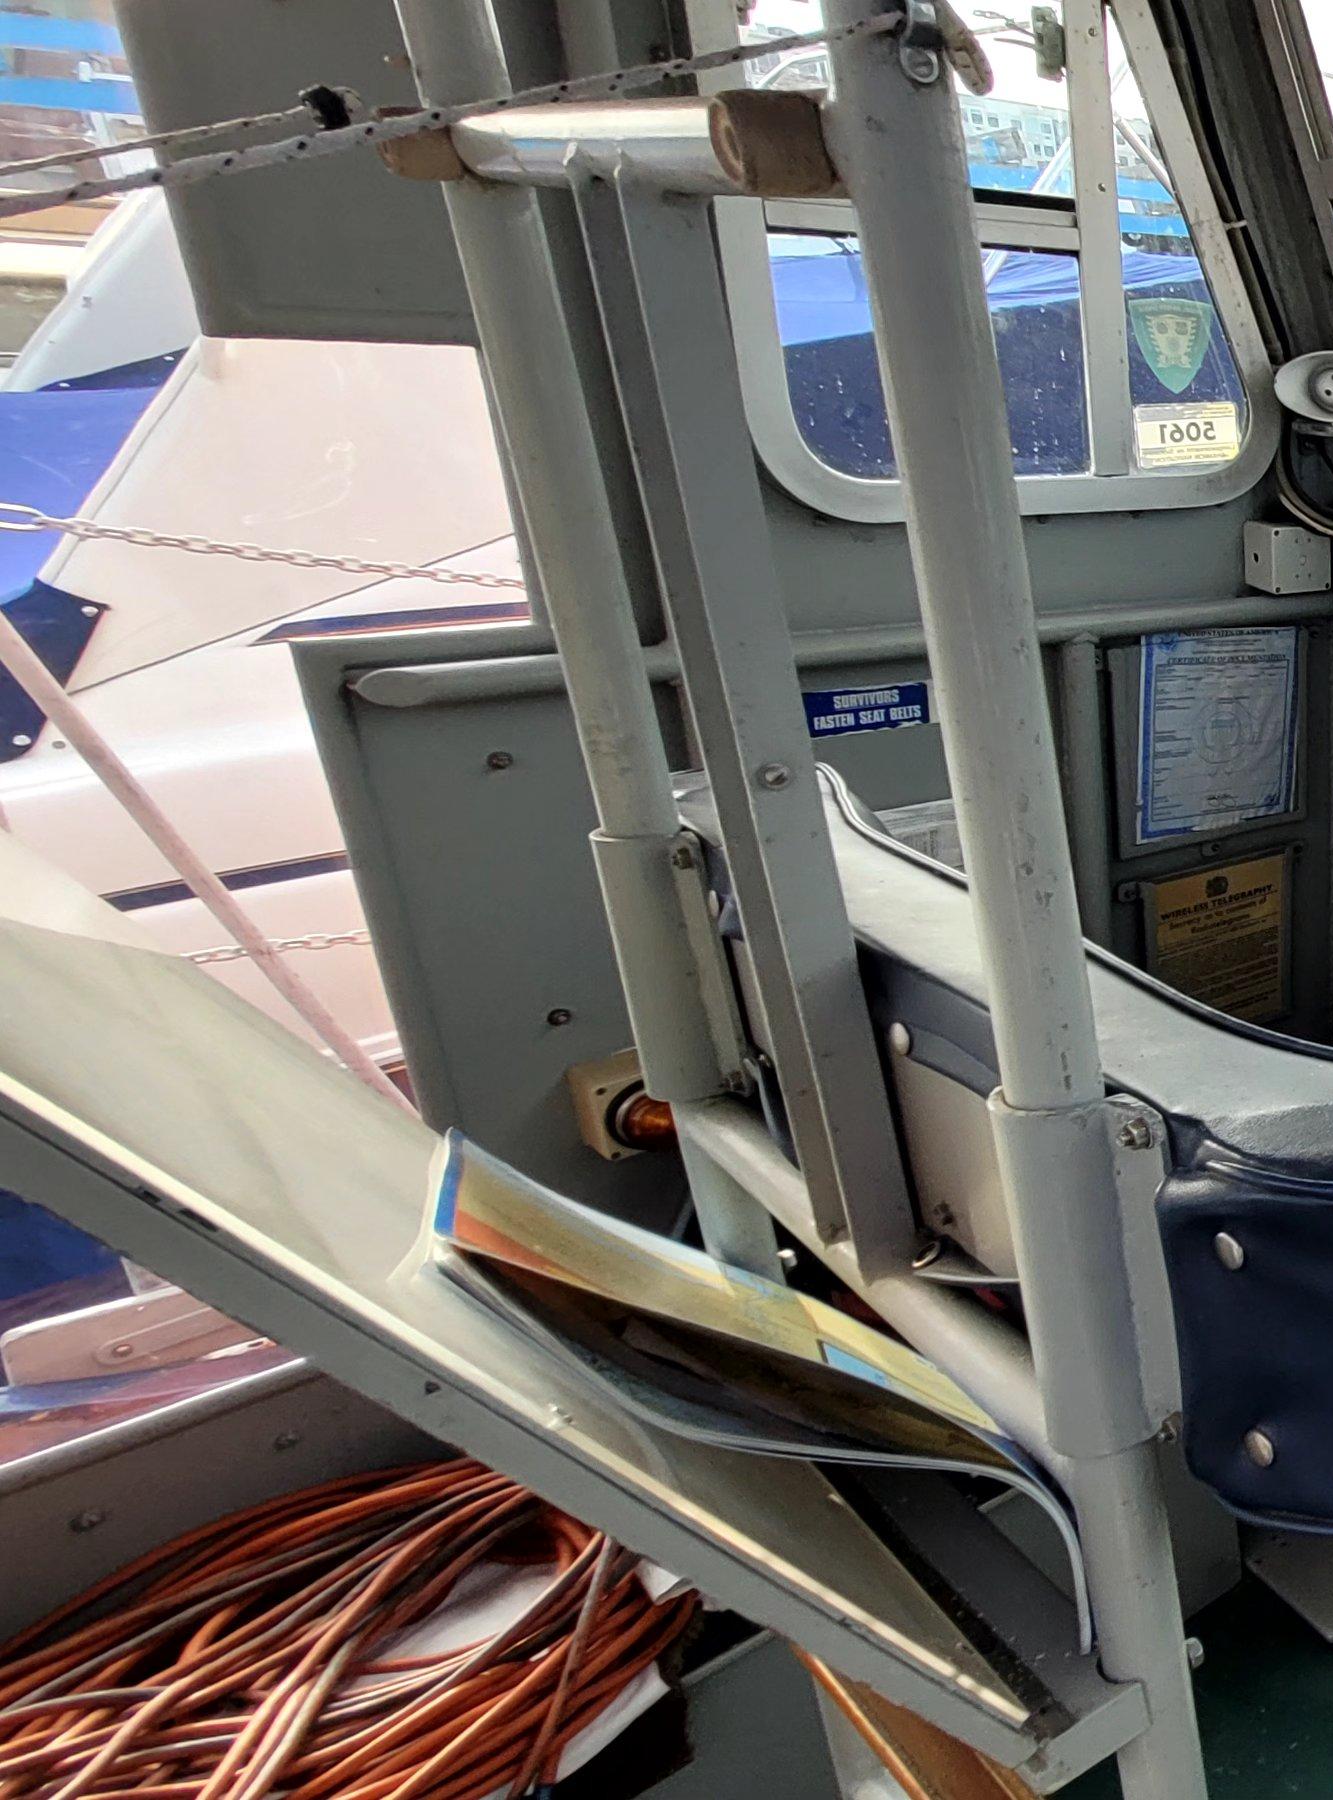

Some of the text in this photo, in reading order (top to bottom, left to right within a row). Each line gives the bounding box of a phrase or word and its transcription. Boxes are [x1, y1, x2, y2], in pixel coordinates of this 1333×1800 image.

[833, 689, 900, 709] SURVIVORS
[813, 705, 921, 730] FASTEN SEAT BELTS
[1161, 884, 1273, 921] WIRELESS TELEGRAPHY
